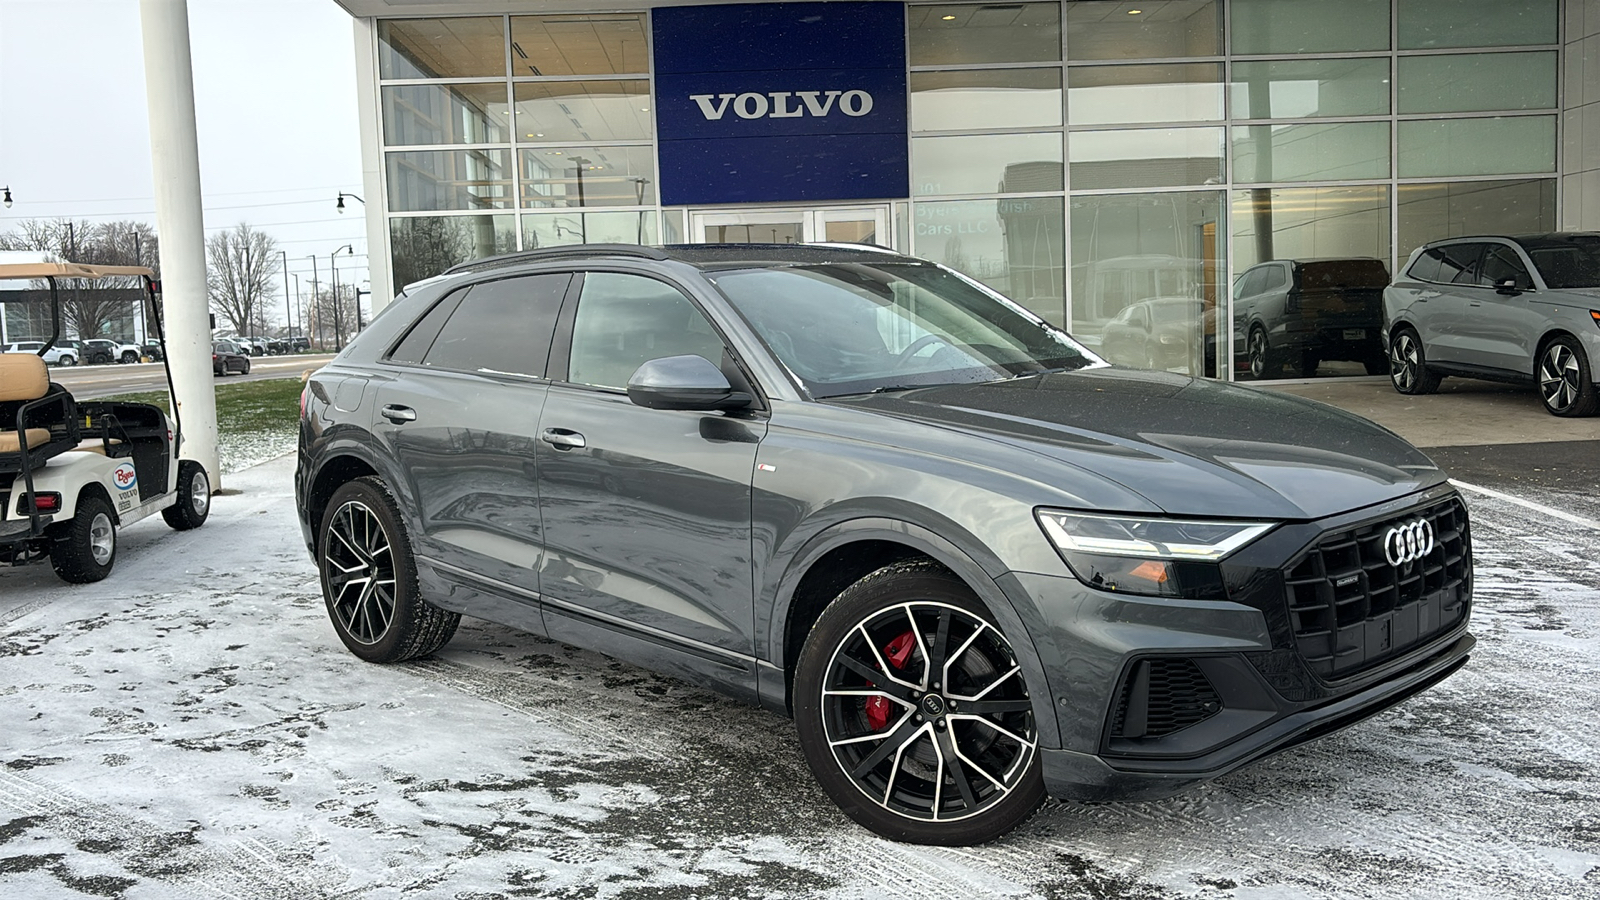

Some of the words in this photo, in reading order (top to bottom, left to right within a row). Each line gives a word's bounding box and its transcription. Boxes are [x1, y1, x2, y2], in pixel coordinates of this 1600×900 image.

[689, 89, 874, 120] VOLVO
[916, 222, 953, 236] Cars
[958, 220, 988, 234] LLC
